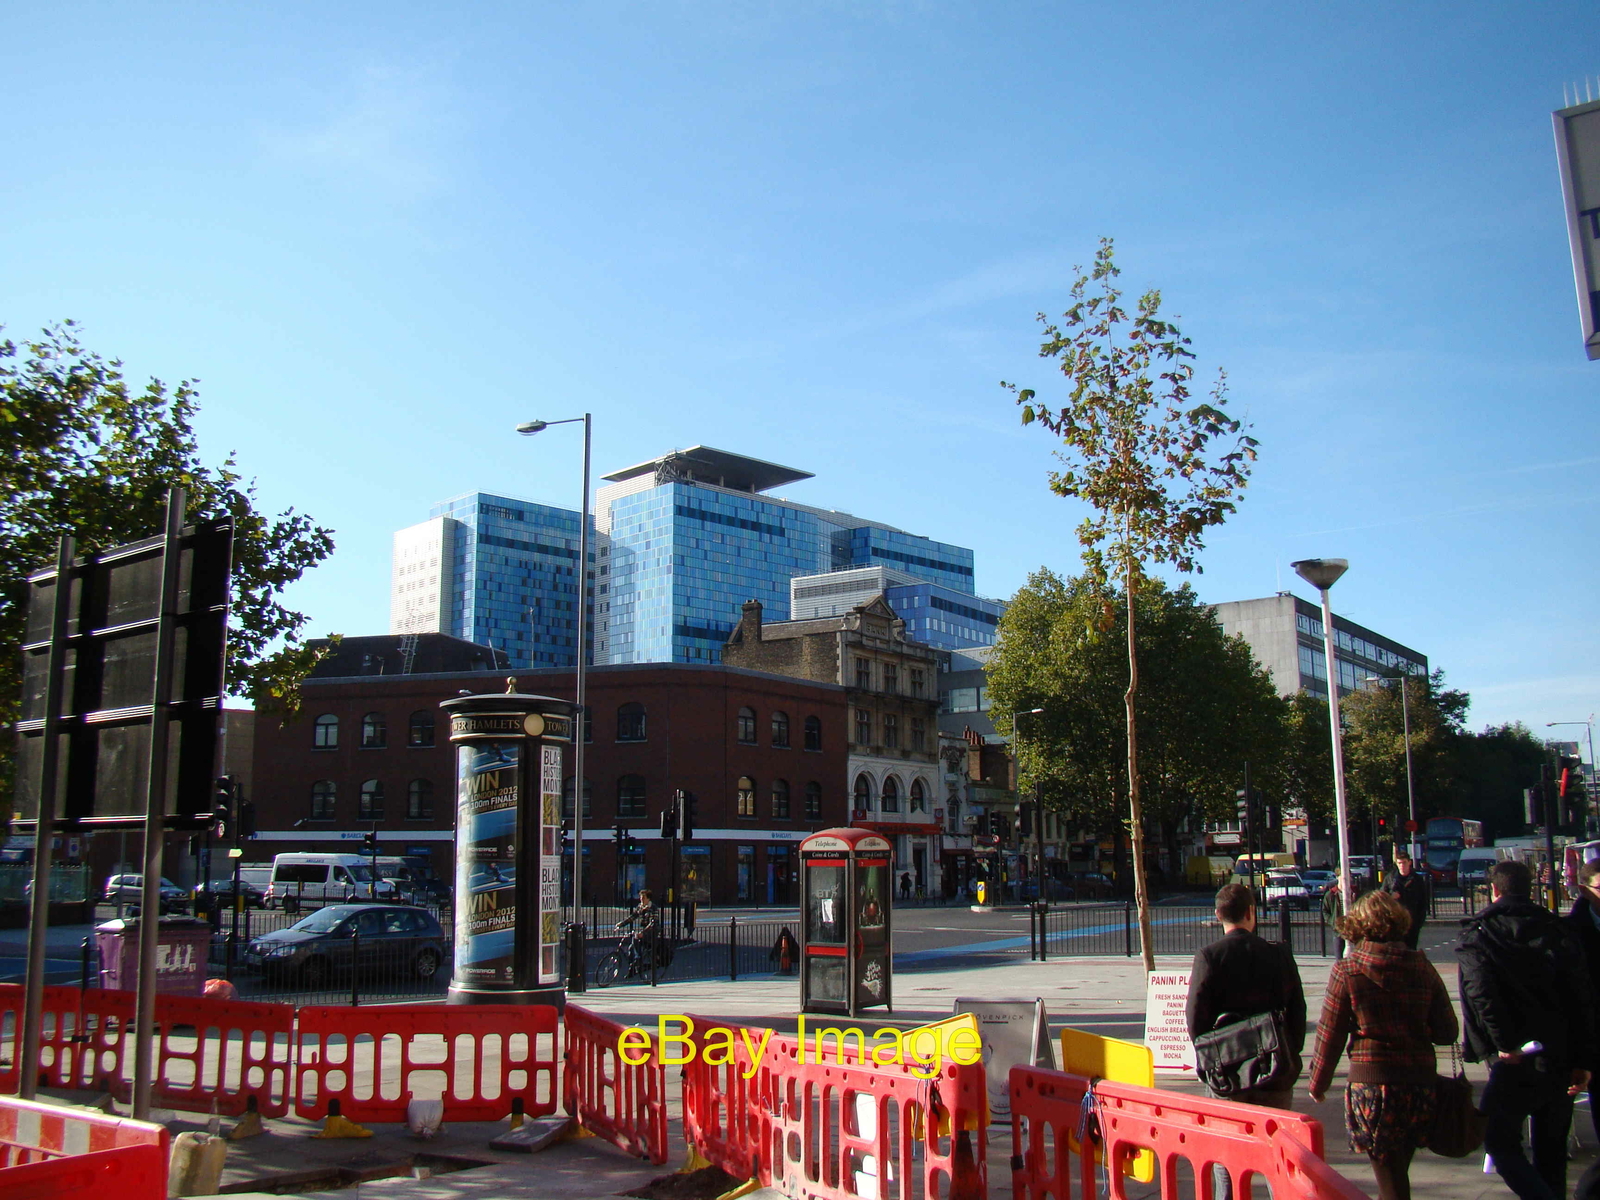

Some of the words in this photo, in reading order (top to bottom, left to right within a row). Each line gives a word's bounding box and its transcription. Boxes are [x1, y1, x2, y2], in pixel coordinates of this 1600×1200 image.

[470, 720, 520, 730] HAMLETS
[543, 750, 561, 765] BLA
[543, 766, 561, 778] HISTOR
[466, 771, 500, 796] WIN
[543, 778, 561, 792] MONT
[470, 789, 498, 802] LONDON
[498, 785, 518, 796] 2012
[471, 799, 490, 810] 100m
[490, 794, 518, 806] FINALS
[815, 840, 837, 848] Telephone
[466, 891, 497, 915] WIN
[542, 896, 559, 910] MONT
[468, 910, 494, 923] LONDON
[496, 905, 516, 917] 2012
[468, 920, 487, 931] 100m
[488, 914, 516, 926] FINALS
[1151, 976, 1176, 986] PANINI
[1149, 1035, 1182, 1043] CAPPUCCINO,
